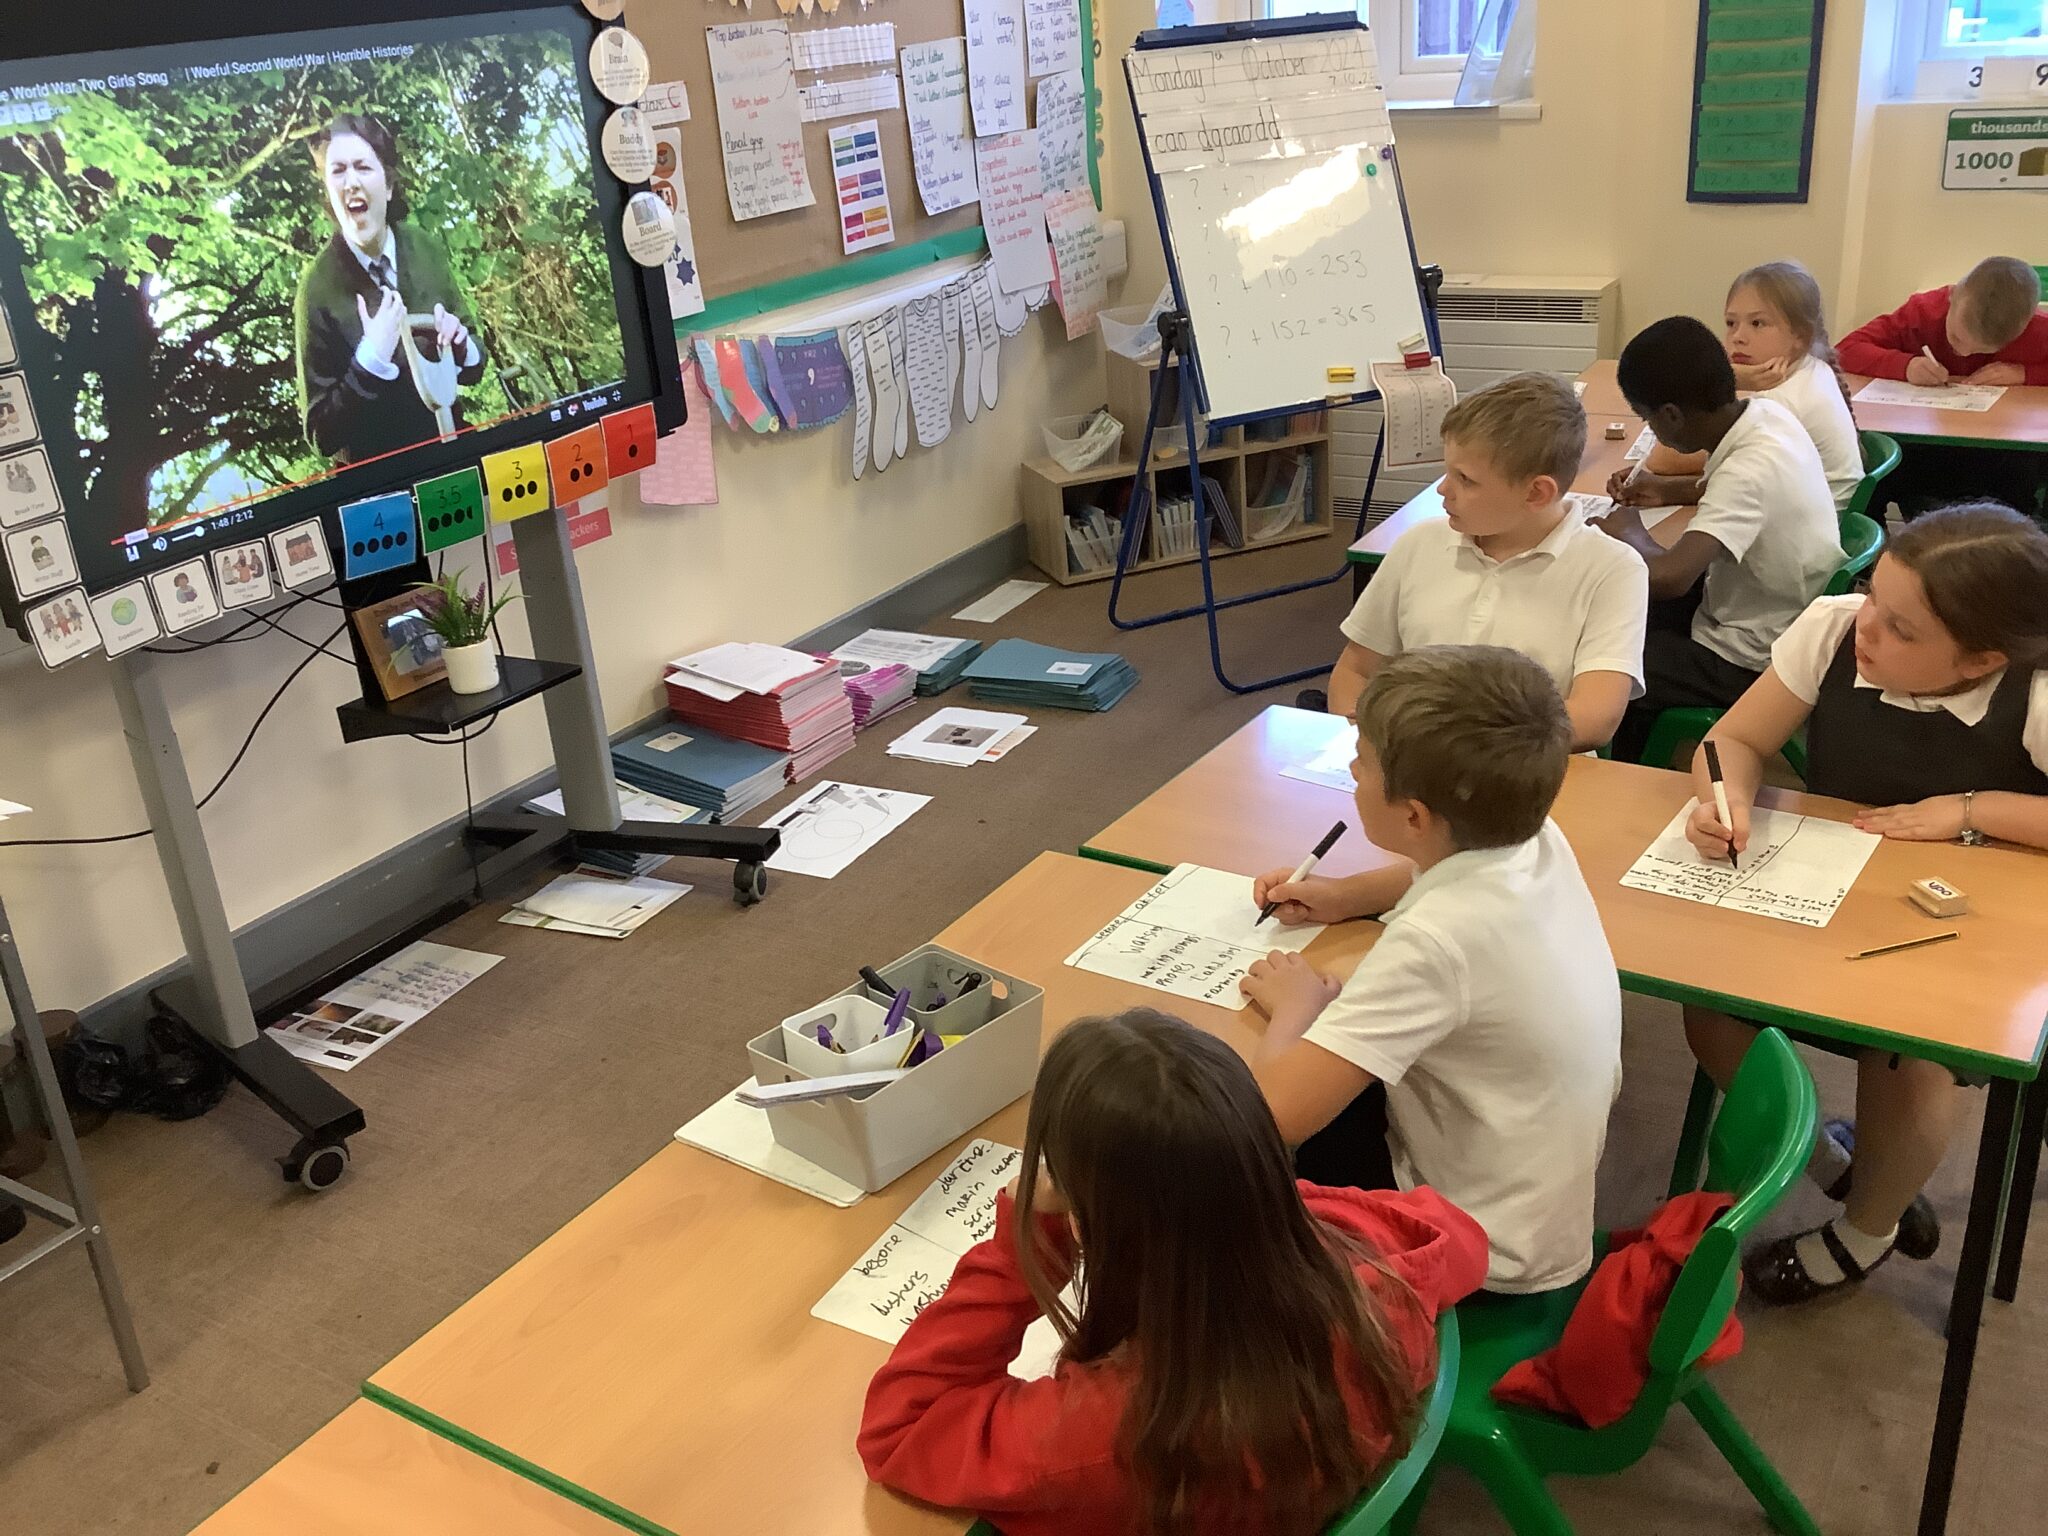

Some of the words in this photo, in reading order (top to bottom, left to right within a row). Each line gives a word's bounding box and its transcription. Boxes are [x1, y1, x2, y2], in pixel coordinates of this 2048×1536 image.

[11, 83, 49, 100] World
[51, 82, 77, 96] War
[78, 78, 106, 92] Two
[107, 74, 136, 89] Girls
[136, 71, 168, 87] Song
[191, 63, 230, 79] Woeful
[231, 59, 272, 75] Second
[273, 55, 304, 71] World
[305, 53, 326, 67] War
[332, 47, 371, 64] Horrible
[372, 43, 414, 59] Histories
[1133, 56, 1206, 103] Monday
[1241, 44, 1307, 98] October
[1969, 66, 1983, 88] 3
[2036, 63, 2048, 86] 9
[1971, 120, 2048, 134] thousands
[619, 133, 643, 146] Buddy
[1155, 131, 1187, 154] cao
[1955, 151, 2014, 170] 1000
[639, 221, 662, 237] Board
[1321, 250, 1368, 278] 253
[1271, 319, 1310, 341] 152
[626, 424, 634, 441] 1
[573, 444, 583, 462] 2
[512, 461, 523, 479] 3
[211, 517, 230, 531] 1:48
[236, 509, 254, 524] 2:12
[373, 513, 385, 531] 4
